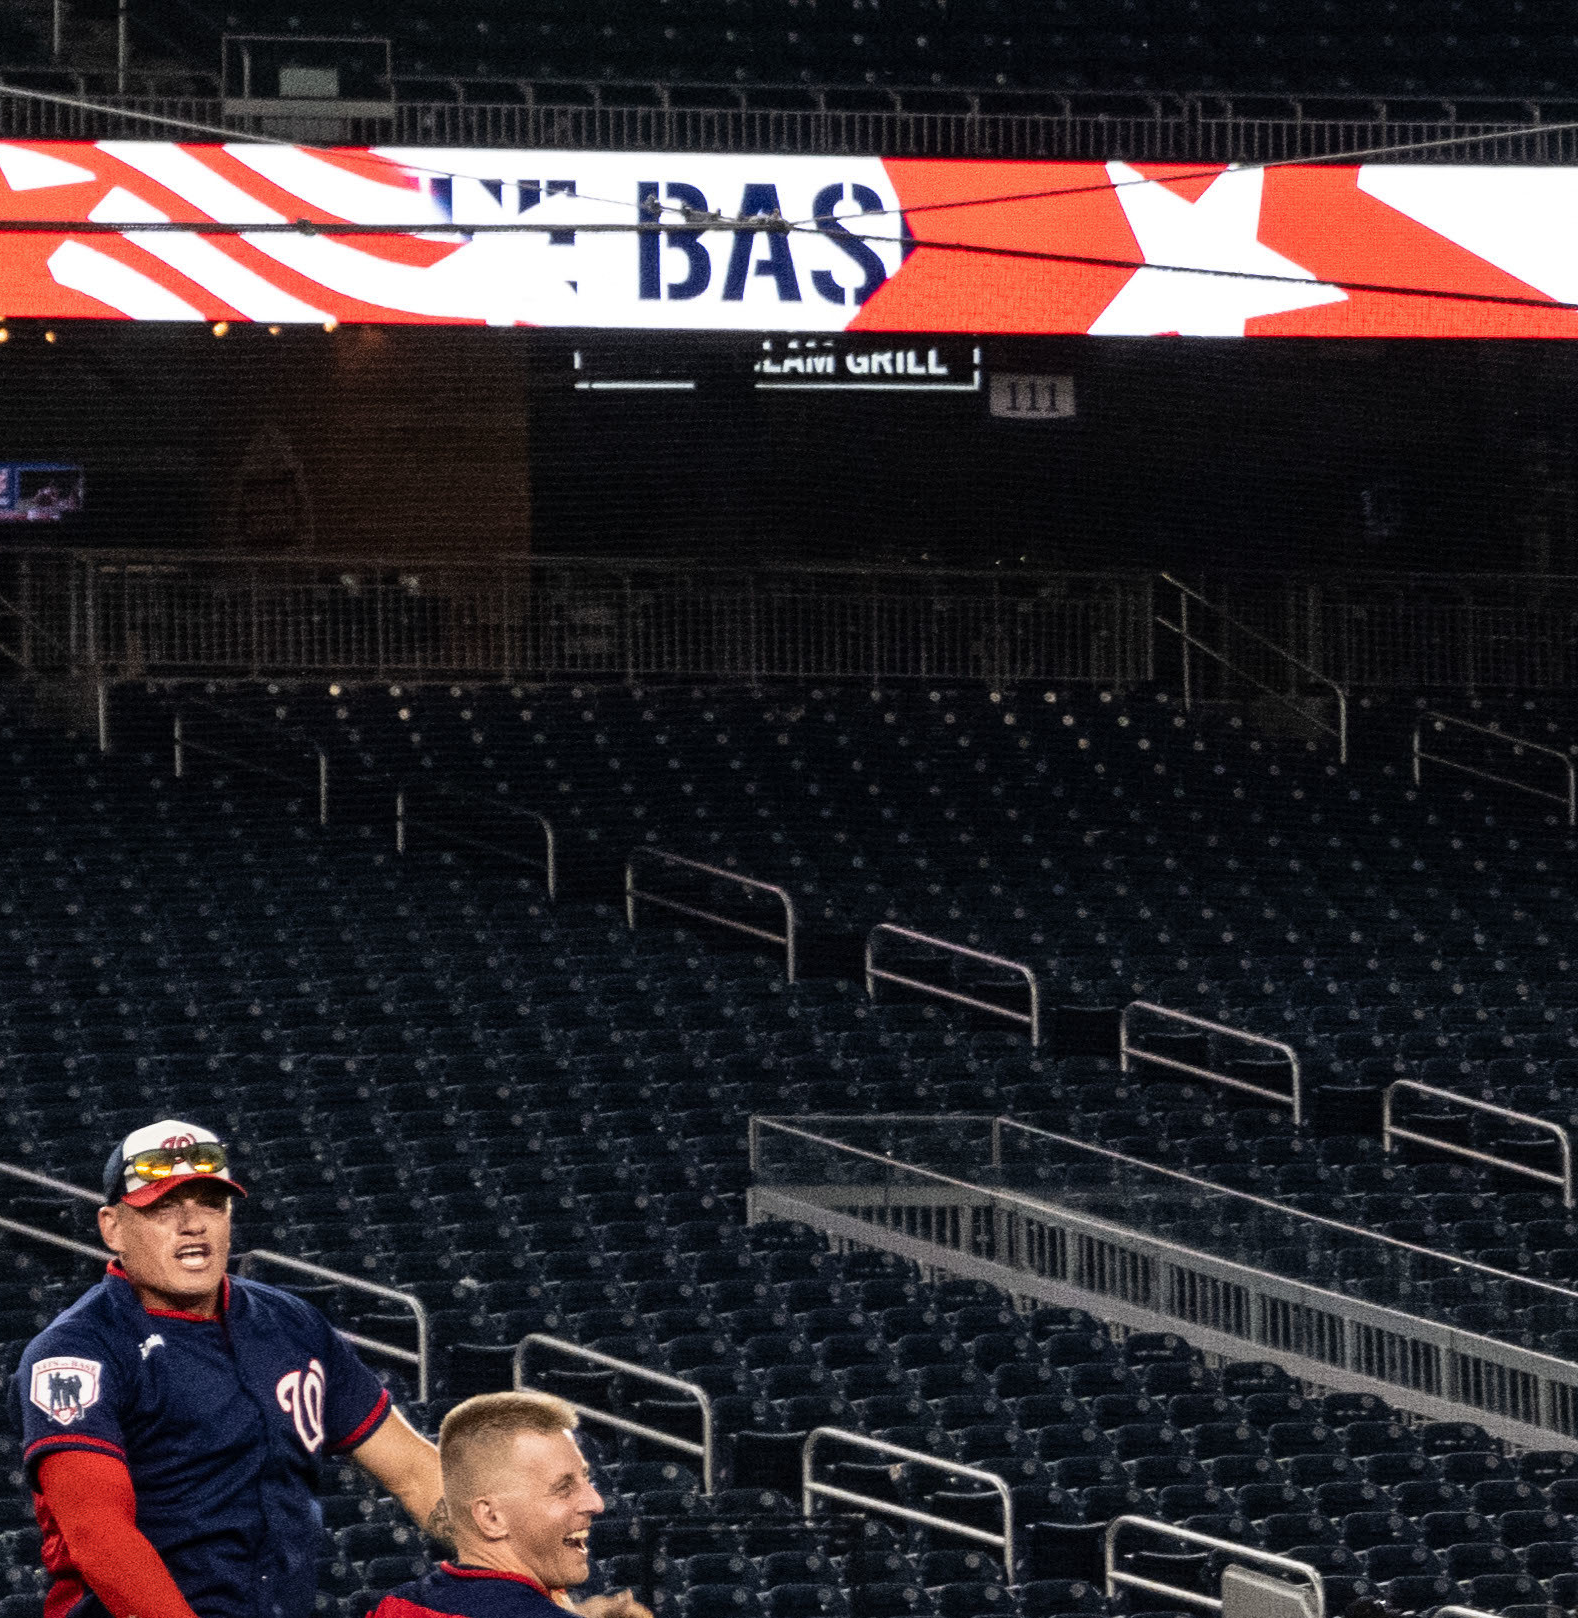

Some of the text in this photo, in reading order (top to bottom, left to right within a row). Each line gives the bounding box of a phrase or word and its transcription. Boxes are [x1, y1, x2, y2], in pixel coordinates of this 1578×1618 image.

[636, 180, 921, 303] BAS
[754, 340, 949, 376] LAM GRILL
[1006, 380, 1061, 413] 111
[276, 1358, 326, 1454] W
